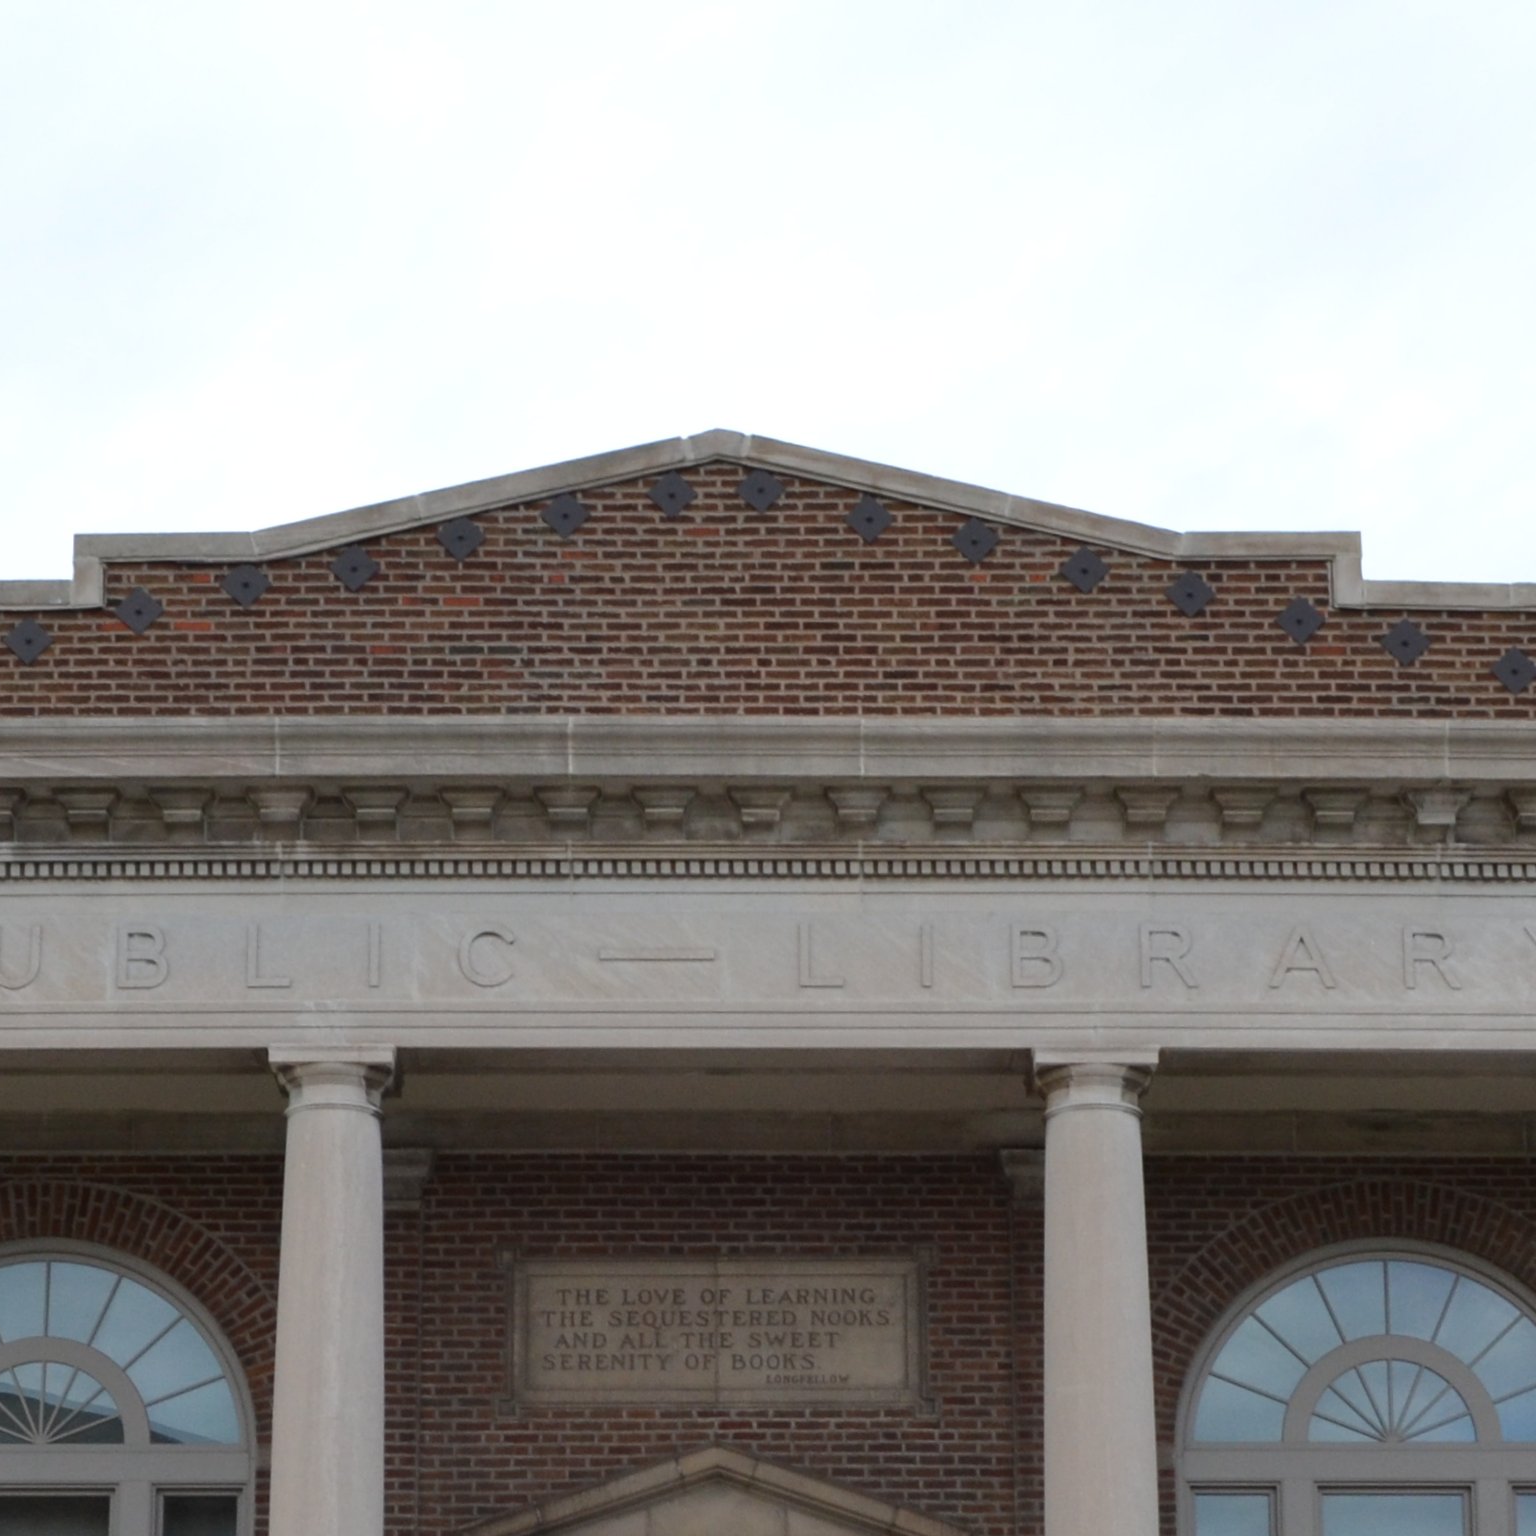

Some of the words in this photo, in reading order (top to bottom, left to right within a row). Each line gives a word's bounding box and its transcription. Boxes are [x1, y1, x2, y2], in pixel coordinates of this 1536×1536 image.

[557, 1288, 609, 1306] THE
[622, 1288, 686, 1306] LOVE
[700, 1288, 732, 1305] OF
[746, 1287, 875, 1305] LEARNING
[542, 1310, 593, 1327] THE
[607, 1310, 797, 1330] SEQUESTERED
[554, 1332, 607, 1349] AND
[620, 1332, 668, 1349] ALL
[680, 1332, 734, 1349] THE
[748, 1332, 841, 1349] SWEET
[542, 1354, 673, 1370] SERENITY
[685, 1354, 717, 1370] OF
[766, 1374, 851, 1385] LONGFELLOW
